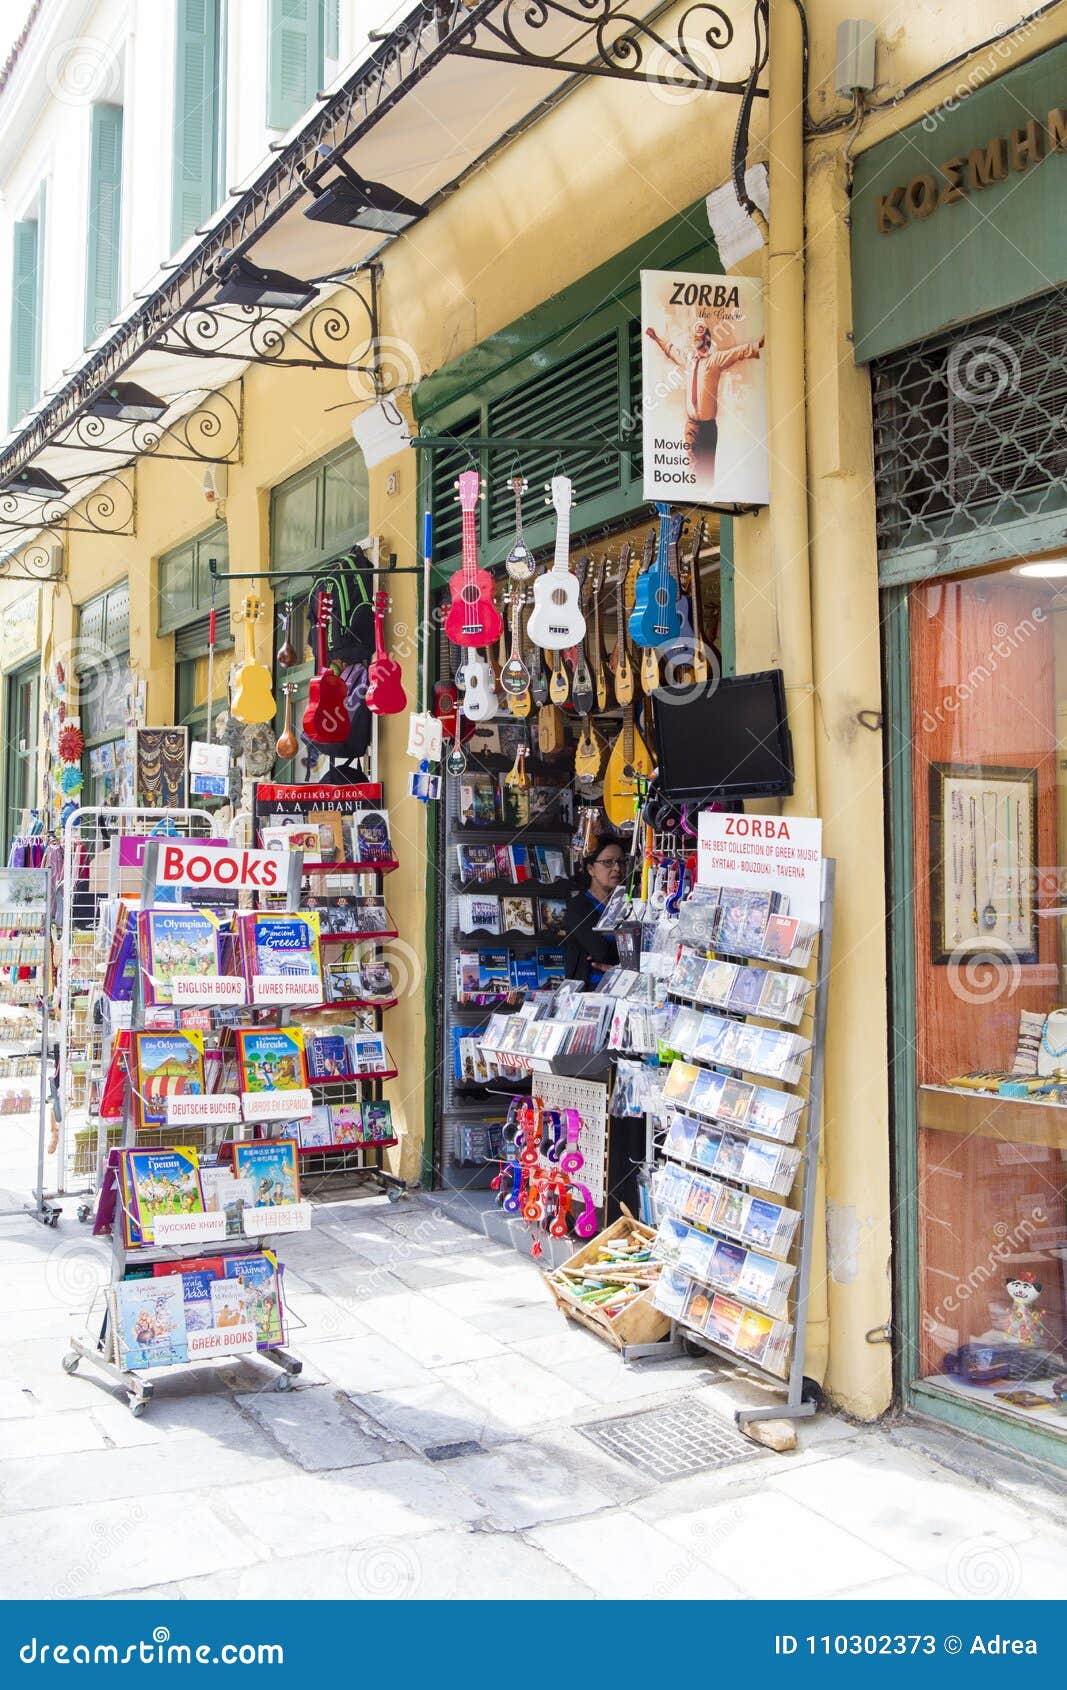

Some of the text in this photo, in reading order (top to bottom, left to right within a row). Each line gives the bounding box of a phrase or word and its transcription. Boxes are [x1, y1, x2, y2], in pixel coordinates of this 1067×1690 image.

[669, 282, 740, 308] ZORBA
[654, 453, 690, 465] Music
[654, 469, 697, 484] Books
[413, 723, 426, 747] 5
[196, 748, 209, 766] 5
[276, 789, 330, 800] Εκδοτικός
[312, 800, 363, 812] ΛΙΒΑΝΗ
[725, 818, 790, 840] ZORBA
[701, 839, 818, 862] THE BEST COLLECTION OF GREEK MUSIC
[163, 846, 278, 886] Books
[711, 857, 736, 871] SYRTAKI
[741, 860, 771, 874] BOUZOUKI
[777, 865, 806, 879] TAVERNA
[163, 919, 212, 930] Olympians
[266, 936, 301, 948] Greece
[178, 982, 242, 994] ENGLISH BOOKS
[258, 983, 319, 995] LIVRES FRANCAIS
[495, 1050, 535, 1071] MUSIC
[172, 1103, 208, 1115] DEUTSCHE
[158, 1219, 224, 1233] русские книги
[184, 1286, 209, 1298] λάδα
[192, 1331, 254, 1351] GREEK BOOKS
